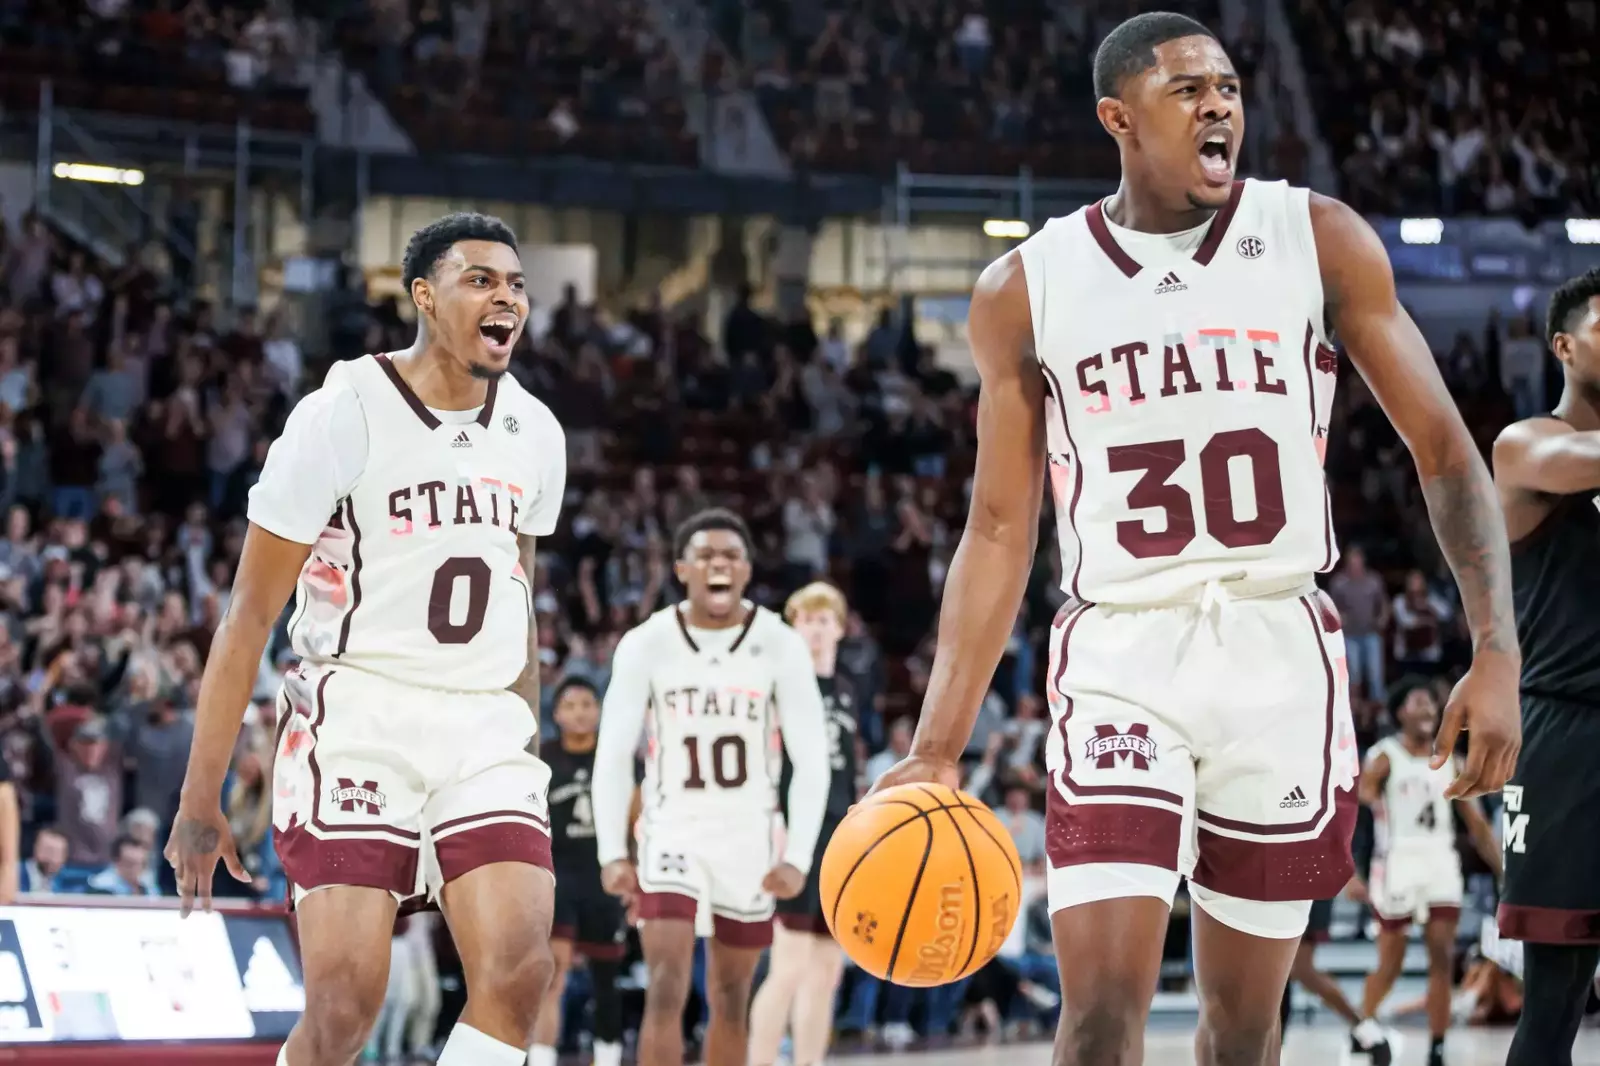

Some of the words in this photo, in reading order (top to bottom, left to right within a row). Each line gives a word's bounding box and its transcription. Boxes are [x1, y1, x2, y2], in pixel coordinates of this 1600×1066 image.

[1240, 238, 1262, 257] SEC
[1154, 283, 1188, 294] adidas
[1076, 328, 1288, 414] STATE
[388, 477, 524, 535] STATE
[1106, 427, 1287, 559] 30
[427, 557, 492, 644] 0
[664, 686, 764, 721] STATE
[1099, 736, 1146, 753] STATE
[683, 736, 747, 789] 10
[340, 789, 378, 803] STATE
[1279, 800, 1309, 808] adidas
[1414, 801, 1436, 832] 4
